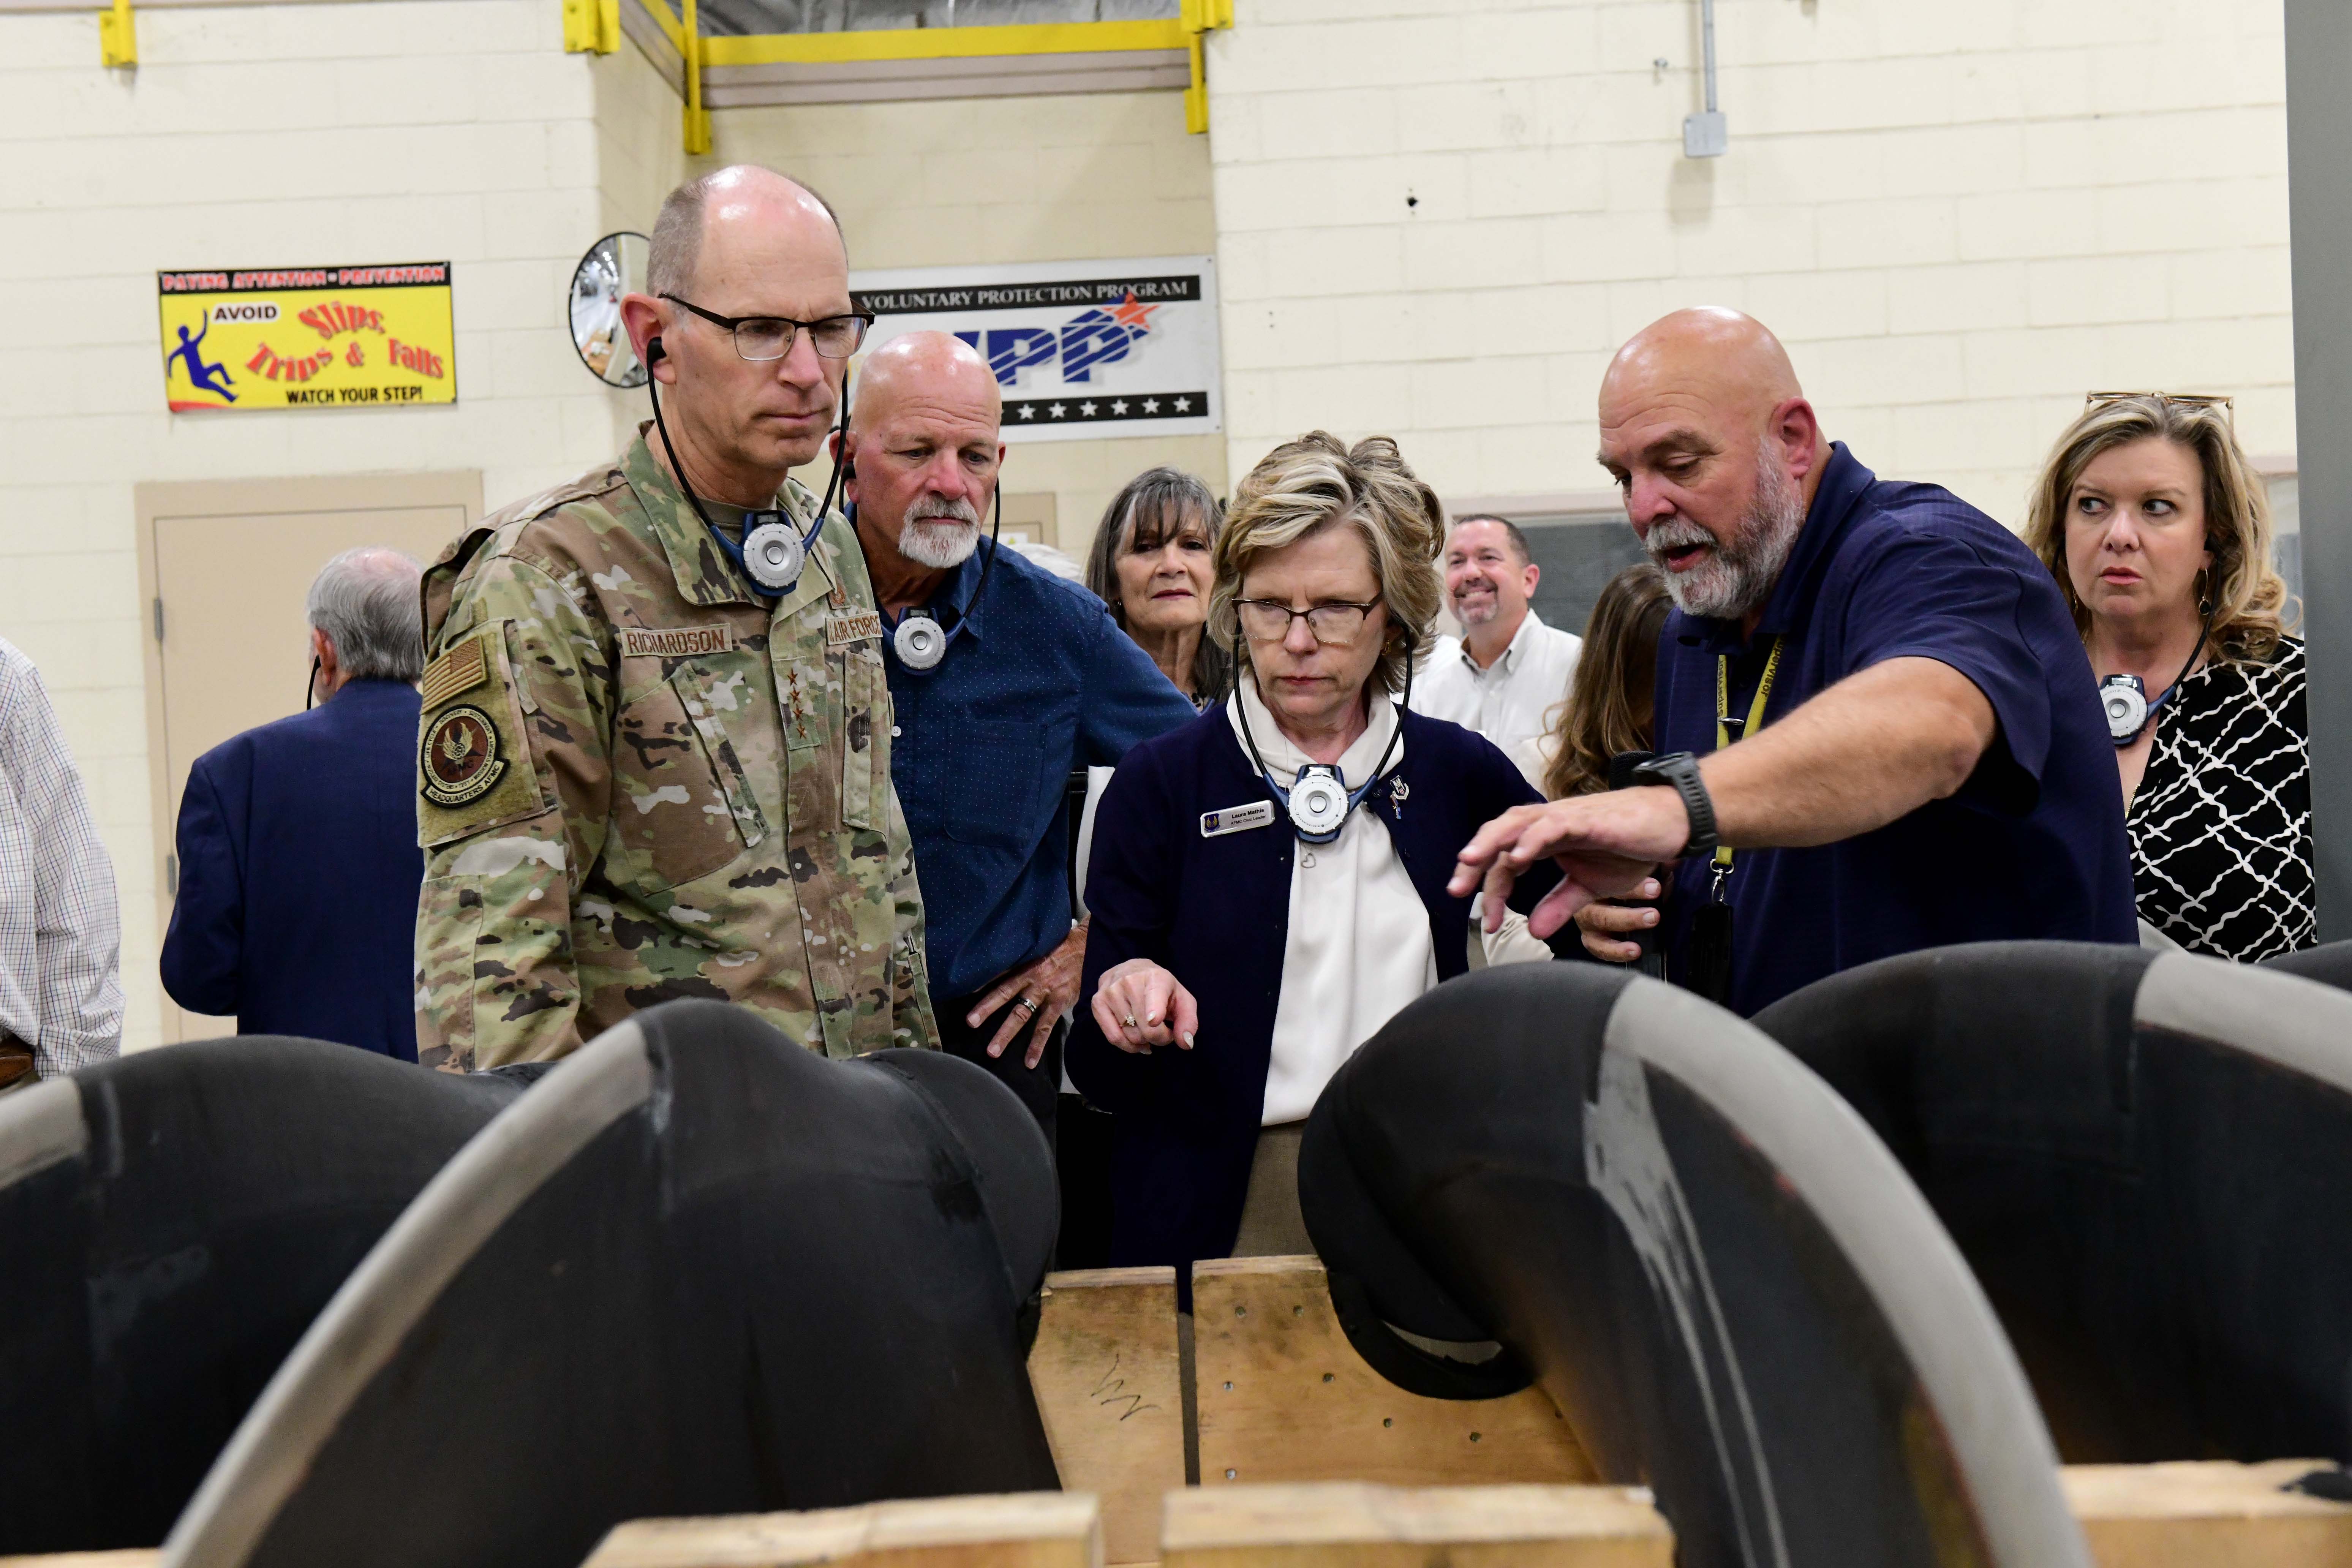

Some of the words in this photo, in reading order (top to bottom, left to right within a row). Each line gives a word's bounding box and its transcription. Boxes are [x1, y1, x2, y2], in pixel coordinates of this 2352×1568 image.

[162, 272, 229, 291] PAYING
[232, 269, 327, 289] ATTENTION
[339, 266, 445, 285] PREVENTION
[861, 291, 974, 310] VOLUNTARY
[977, 285, 1092, 304] PROTECTION
[1097, 281, 1187, 299] PROGRAM
[215, 306, 277, 320] AVOID
[245, 342, 334, 382] Trips
[345, 342, 364, 367] &
[388, 338, 444, 379] Falls
[286, 389, 335, 404] WATCH
[340, 387, 378, 402] YOUR
[384, 386, 422, 401] STEP!
[627, 629, 726, 653] RICHARDSON
[834, 620, 851, 642] AIR
[847, 614, 881, 638] FORCE
[1761, 639, 1784, 697] upervisor
[430, 785, 484, 803] HEADQUARTERS
[484, 765, 500, 786] AFMC
